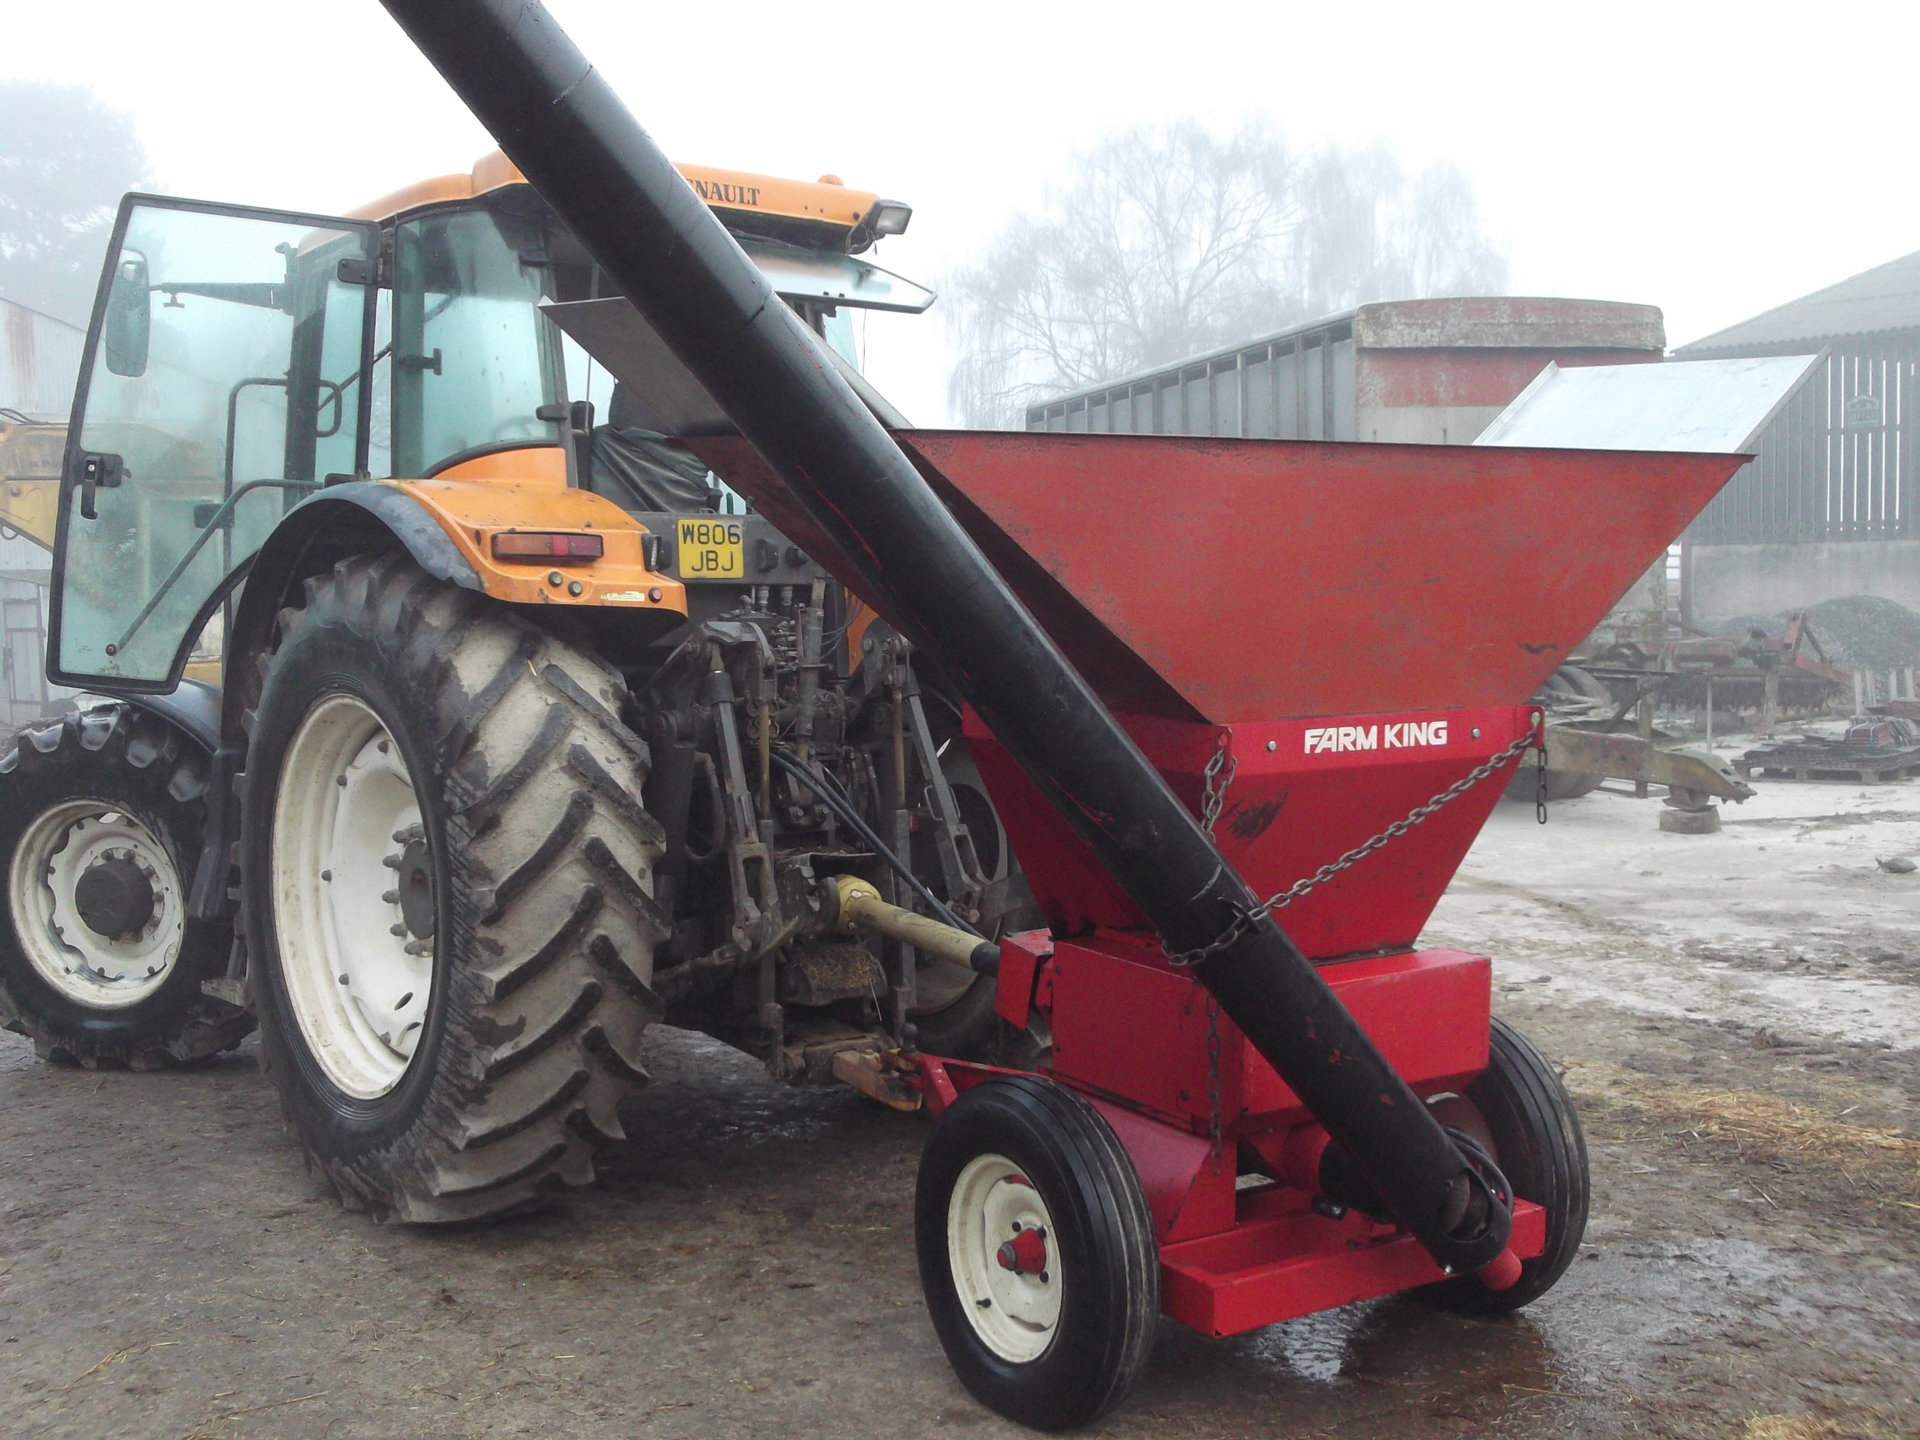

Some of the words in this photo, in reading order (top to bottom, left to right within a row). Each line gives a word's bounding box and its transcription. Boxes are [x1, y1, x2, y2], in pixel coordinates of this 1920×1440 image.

[685, 178, 760, 206] NAULT
[681, 523, 740, 545] W806
[691, 550, 734, 572] JBJ
[1304, 725, 1378, 754] FARM
[1384, 720, 1448, 748] KING
